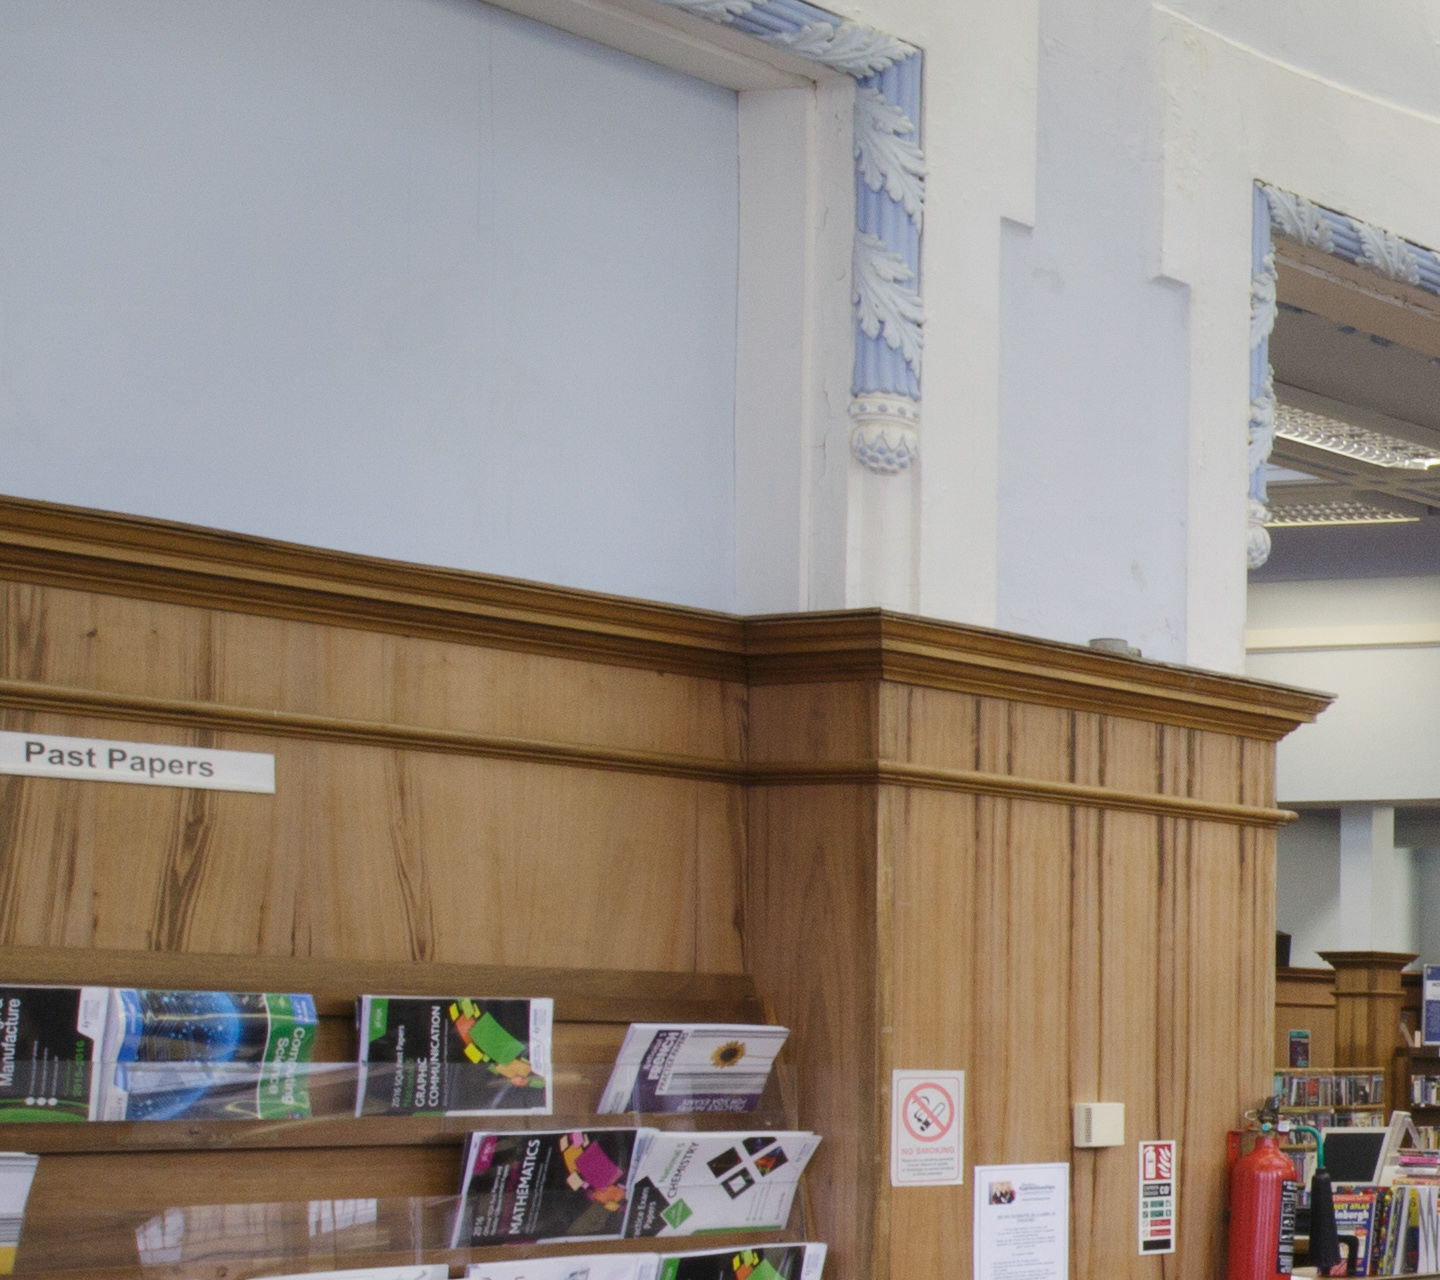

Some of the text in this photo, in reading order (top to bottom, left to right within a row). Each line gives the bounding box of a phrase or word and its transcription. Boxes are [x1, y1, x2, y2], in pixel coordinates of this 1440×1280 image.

[25, 741, 215, 778] Past Papers
[2, 997, 21, 1087] Manufacture
[428, 1005, 441, 1108] COMMUNICATION
[415, 1057, 428, 1108] GRAPHIC
[667, 1142, 699, 1198] CHEMISTRY
[901, 1146, 955, 1156] NO SMOKING
[508, 1139, 541, 1235] MATHEMATICS
